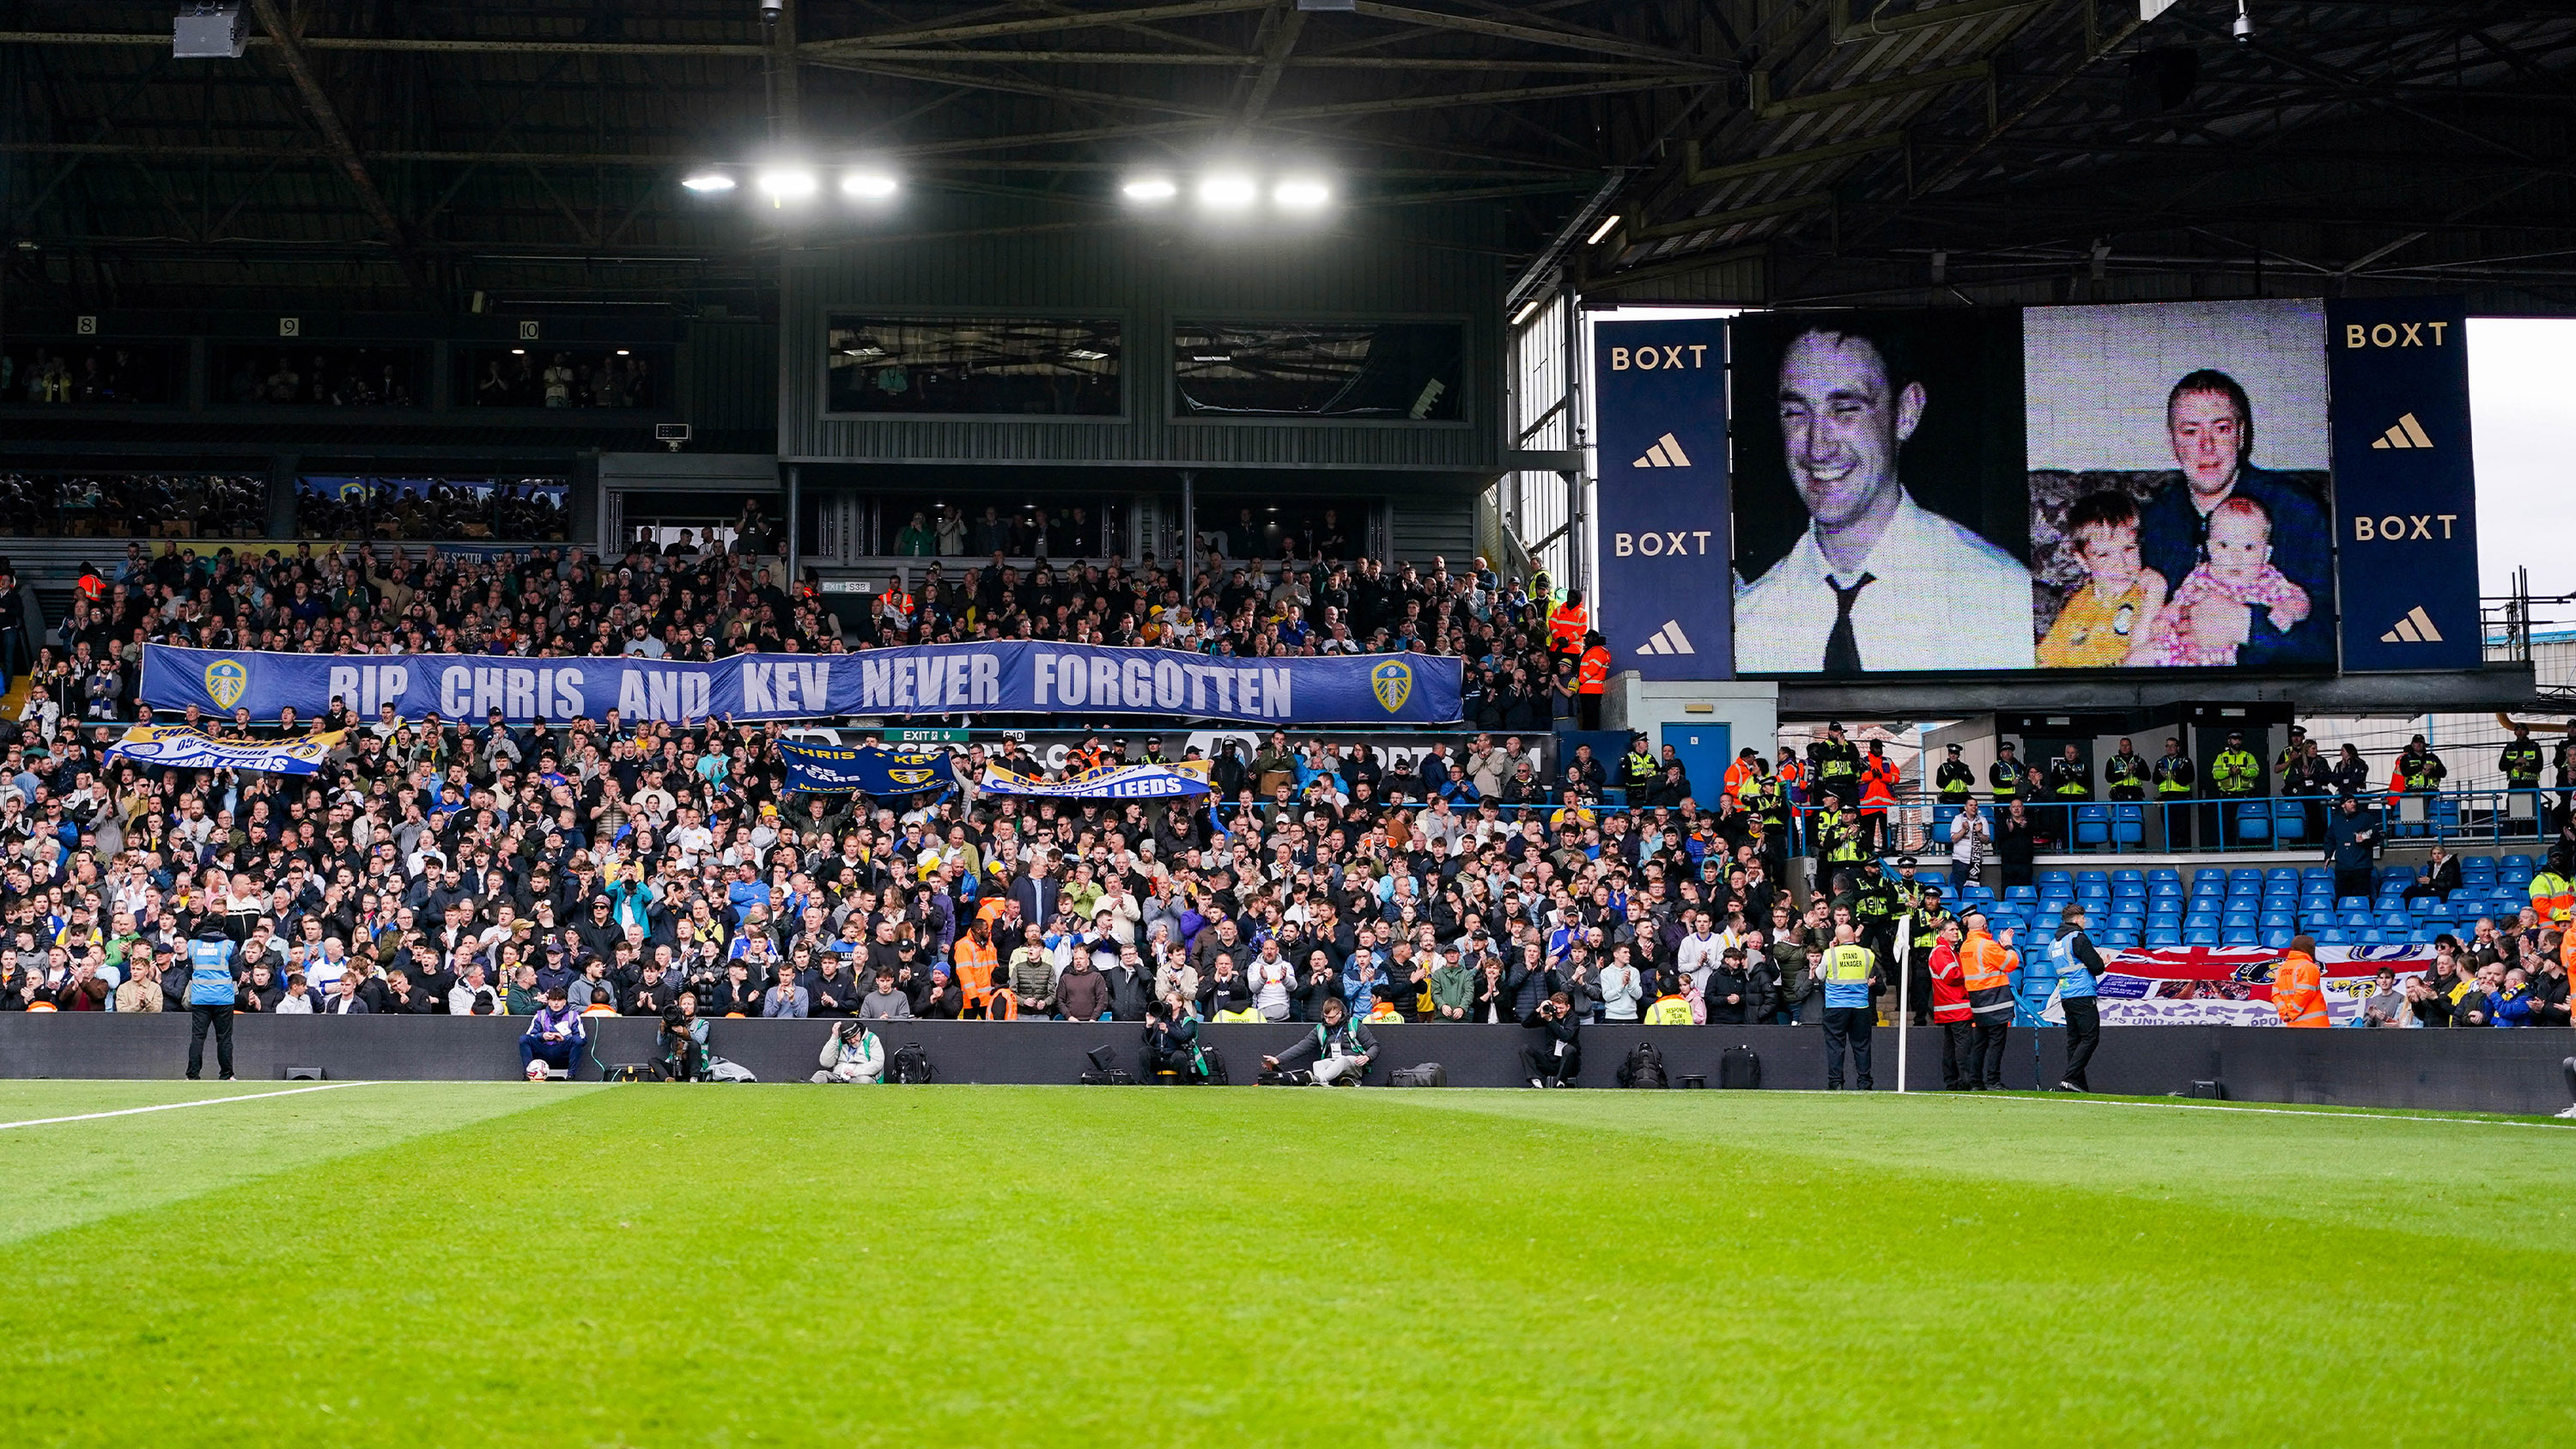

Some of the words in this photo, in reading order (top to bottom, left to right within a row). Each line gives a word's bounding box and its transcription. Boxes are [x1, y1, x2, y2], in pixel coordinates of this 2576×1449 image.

[81, 318, 92, 332] 8
[283, 320, 295, 334] 9
[521, 323, 538, 338] 10
[2347, 322, 2447, 348] BOXT
[1612, 344, 1707, 371] BOXT
[2355, 515, 2457, 541] BOXT
[1616, 531, 1711, 557] BOXT
[329, 665, 408, 715] RIP
[441, 665, 585, 718] CHRIS
[617, 669, 711, 721] AND
[743, 662, 830, 713] KEV
[862, 654, 1000, 708] NEVER
[1034, 654, 1291, 718] FORGOTTEN
[903, 731, 930, 740] EXIT
[782, 744, 856, 760] CHRIS
[895, 753, 940, 765] KEV
[792, 764, 861, 782] YEARS
[811, 764, 836, 776] 25
[1114, 777, 1182, 797] LEEDS
